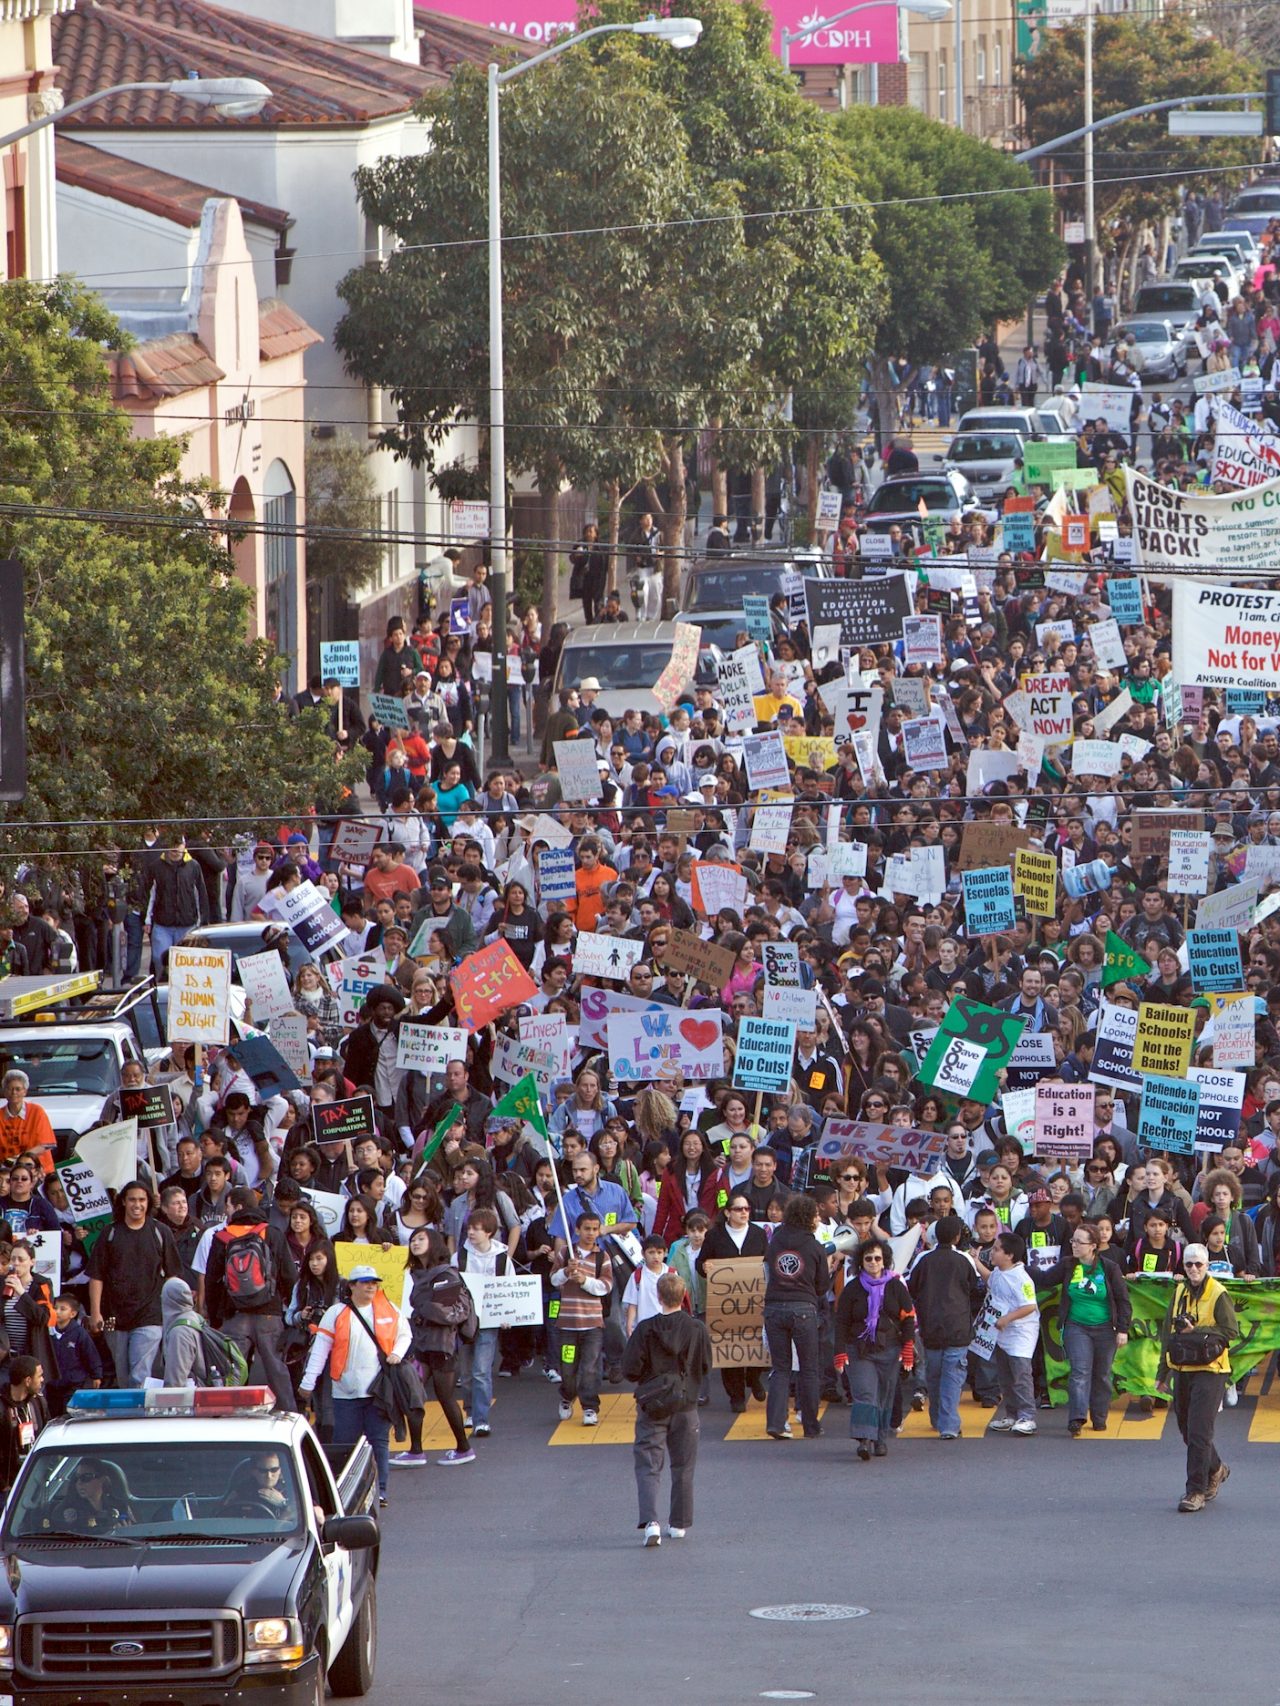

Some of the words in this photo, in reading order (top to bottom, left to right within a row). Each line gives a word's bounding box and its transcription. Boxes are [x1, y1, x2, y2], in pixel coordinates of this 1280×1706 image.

[814, 30, 871, 48] CDPH
[1133, 480, 1187, 511] CCSF
[1231, 498, 1255, 512] No
[1138, 506, 1209, 536] FIGHTS
[1139, 531, 1199, 559] BACK!
[1115, 581, 1132, 589] Fund
[1111, 590, 1139, 599] Schools
[1198, 591, 1275, 609] PROTEST
[820, 608, 861, 618] BUDGET
[867, 606, 896, 615] CUTS
[823, 601, 886, 610] EDUCATION
[1112, 604, 1123, 612] Not
[1126, 603, 1141, 612] War!
[844, 617, 871, 627] STOP
[330, 644, 350, 653] Fund
[323, 654, 357, 663] Schools
[1208, 649, 1238, 668] Not
[1241, 650, 1267, 670] for
[323, 667, 336, 676] Not
[339, 665, 358, 676] War!
[1025, 678, 1070, 694] DREAM
[1196, 674, 1234, 685] ANSWER
[1237, 677, 1277, 688] Coalition
[1030, 698, 1060, 715] ACT
[1033, 718, 1071, 735] NOW!
[1170, 831, 1204, 839] WITHOUT
[964, 873, 1010, 886] Financiar
[967, 887, 1011, 901] Escuelas
[984, 902, 996, 912] NO
[969, 910, 1014, 923] Guerras!
[1193, 932, 1231, 944] Defend
[1189, 945, 1238, 958] Education
[175, 955, 224, 969] EDUCATION
[1193, 964, 1209, 977] No
[1213, 961, 1241, 976] Cuts!
[203, 976, 213, 988] A
[180, 992, 215, 1008] HUMAN
[176, 1014, 216, 1028] RIGHT
[1146, 1007, 1188, 1022] Bailout
[641, 1015, 672, 1037] WE
[746, 1022, 789, 1037] Defend
[1139, 1022, 1191, 1040] Schools!
[634, 1037, 681, 1061] LOVE
[740, 1037, 792, 1053] Education
[951, 1041, 980, 1060] Save
[1143, 1043, 1162, 1055] Not
[1164, 1043, 1182, 1056] the
[614, 1058, 652, 1079] OUR
[656, 1059, 720, 1080] STAFF
[738, 1056, 755, 1071] No
[759, 1058, 788, 1075] Cuts!
[945, 1052, 968, 1071] Our
[1141, 1056, 1179, 1071] Banks!
[940, 1065, 972, 1088] Schools
[1038, 1088, 1091, 1099] Education
[1146, 1081, 1182, 1095] Defiende
[1186, 1089, 1196, 1099] la
[1052, 1104, 1063, 1116] is
[1069, 1107, 1076, 1116] a
[1144, 1096, 1194, 1114] Educación
[320, 1108, 349, 1124] TAX
[1161, 1115, 1174, 1126] No
[829, 1122, 868, 1139] WE
[876, 1127, 945, 1152] LOVE
[1043, 1123, 1084, 1138] Right!
[1141, 1122, 1192, 1141] Recortes!
[823, 1140, 868, 1157] OUR
[866, 1145, 940, 1173] STAFF
[61, 1168, 94, 1184] Save
[66, 1182, 92, 1198] Our
[72, 1196, 109, 1212] Schools
[721, 1299, 763, 1315] OUR
[716, 1344, 771, 1364] NOW!
